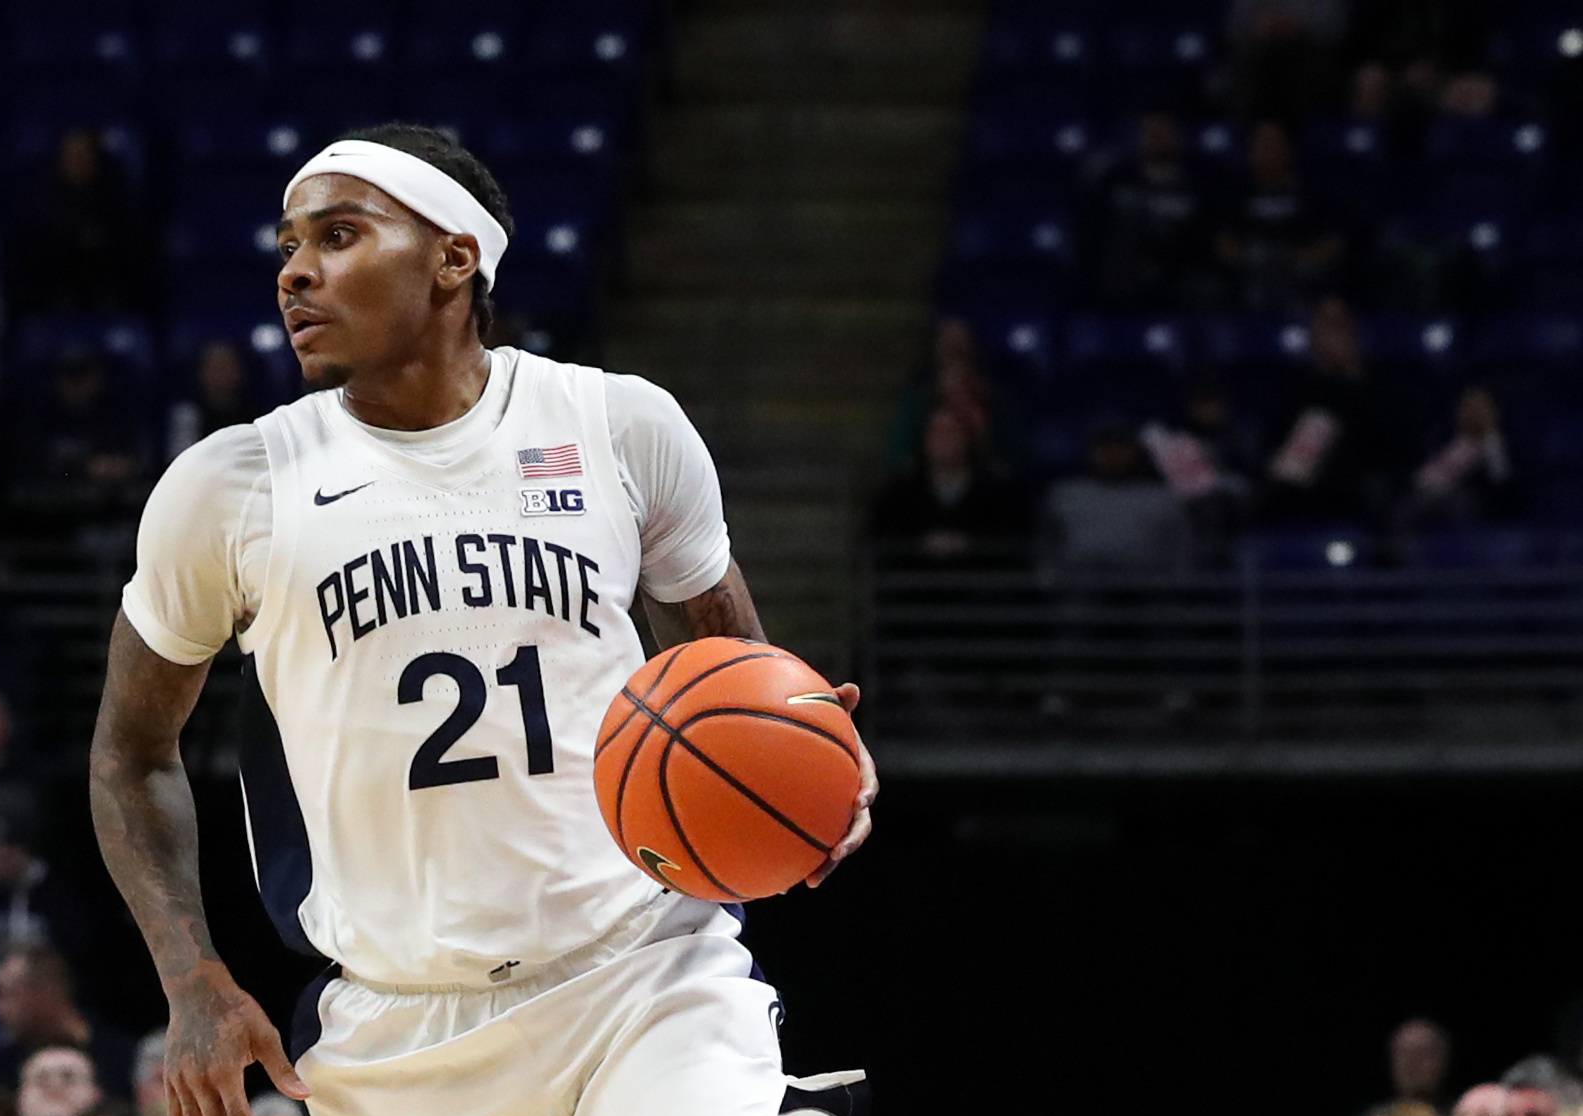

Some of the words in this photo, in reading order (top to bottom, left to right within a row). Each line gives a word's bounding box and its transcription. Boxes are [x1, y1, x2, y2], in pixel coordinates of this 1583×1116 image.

[317, 535, 441, 661] PENN
[456, 533, 601, 637] STATE
[396, 644, 554, 791] 21
